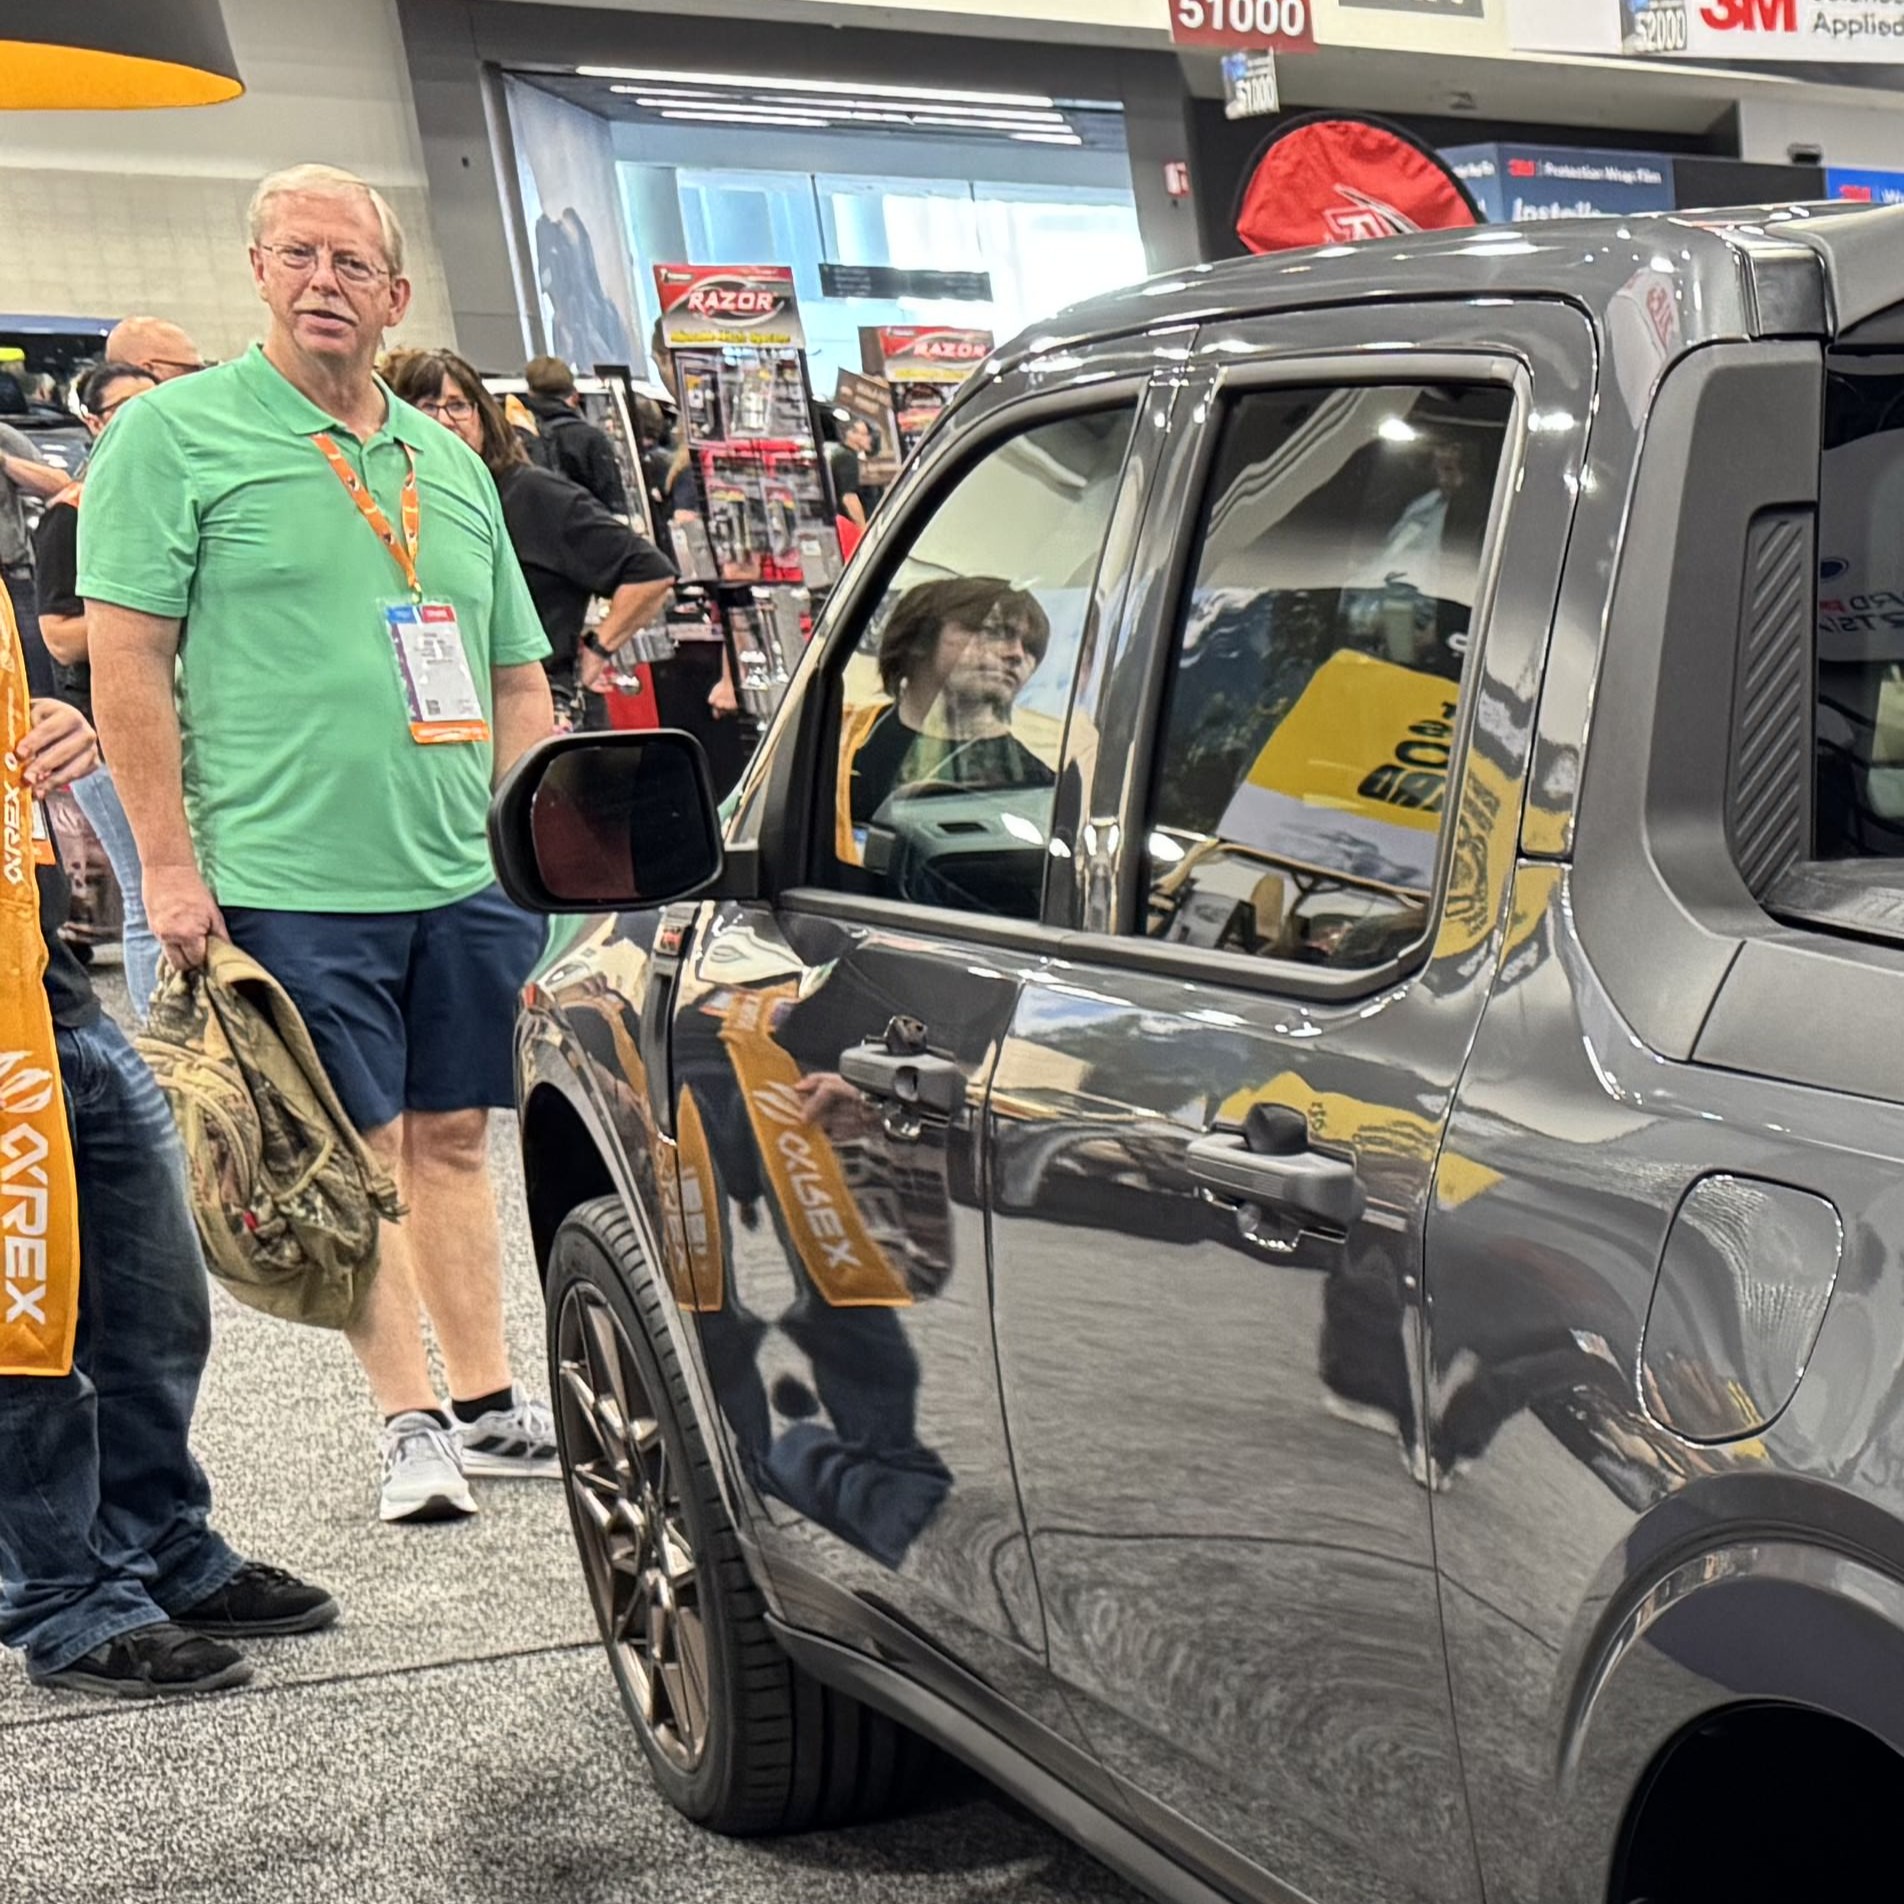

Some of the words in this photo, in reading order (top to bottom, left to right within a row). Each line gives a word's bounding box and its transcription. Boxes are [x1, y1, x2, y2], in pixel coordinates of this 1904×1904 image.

[1699, 0, 1798, 33] 3M
[1812, 11, 1900, 38] Applied
[687, 290, 774, 317] RAZOR
